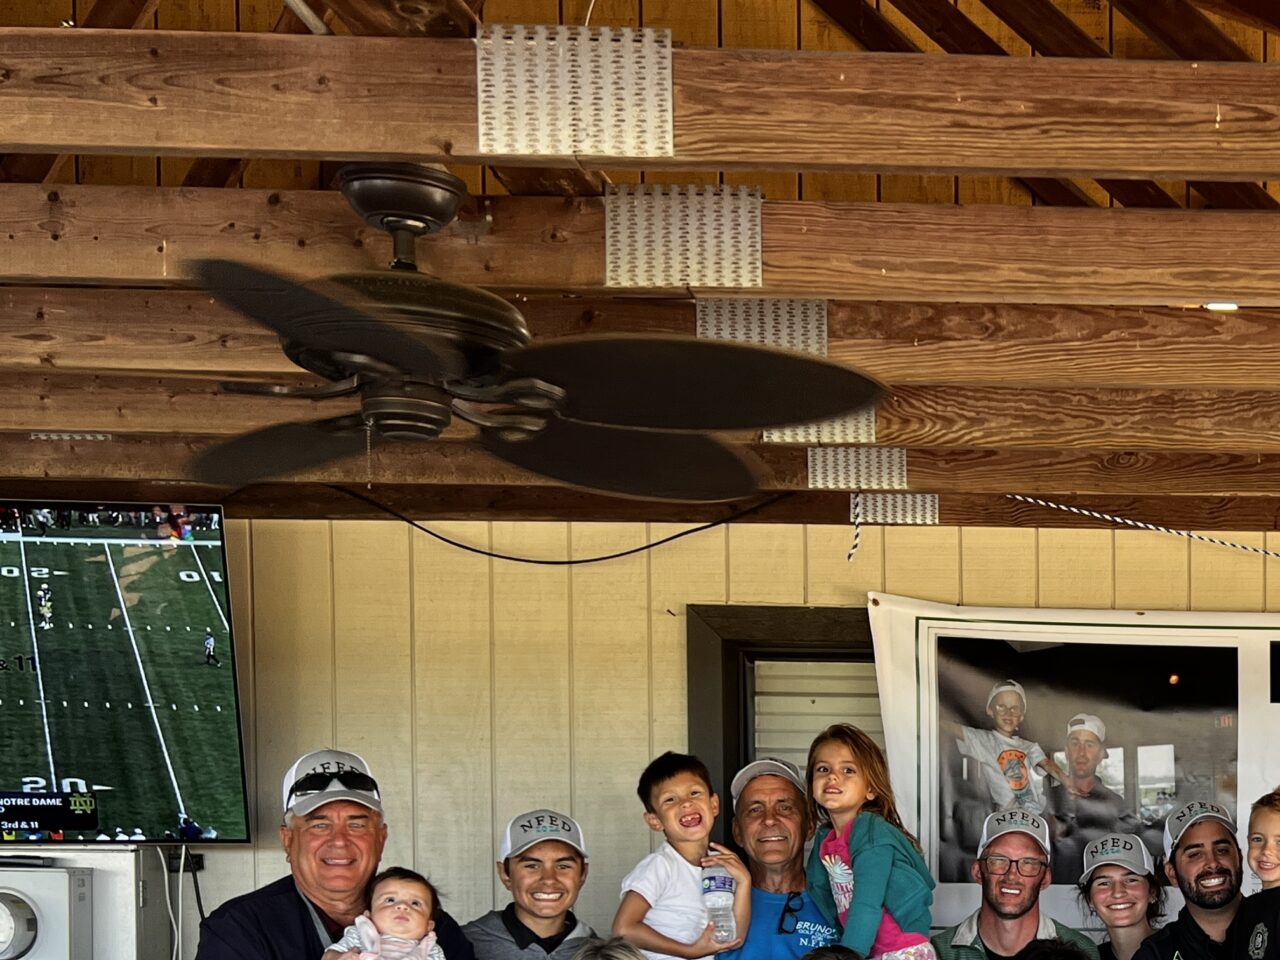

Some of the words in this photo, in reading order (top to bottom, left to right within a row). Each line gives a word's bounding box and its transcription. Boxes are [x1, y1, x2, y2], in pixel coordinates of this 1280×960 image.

[32, 798, 62, 806] DAME
[995, 811, 1040, 829] NFED
[1176, 802, 1220, 822] NFED
[1, 821, 18, 829] 3rd
[520, 815, 571, 833] NFED
[1090, 837, 1133, 859] NFED
[796, 921, 837, 935] BRUNO'
